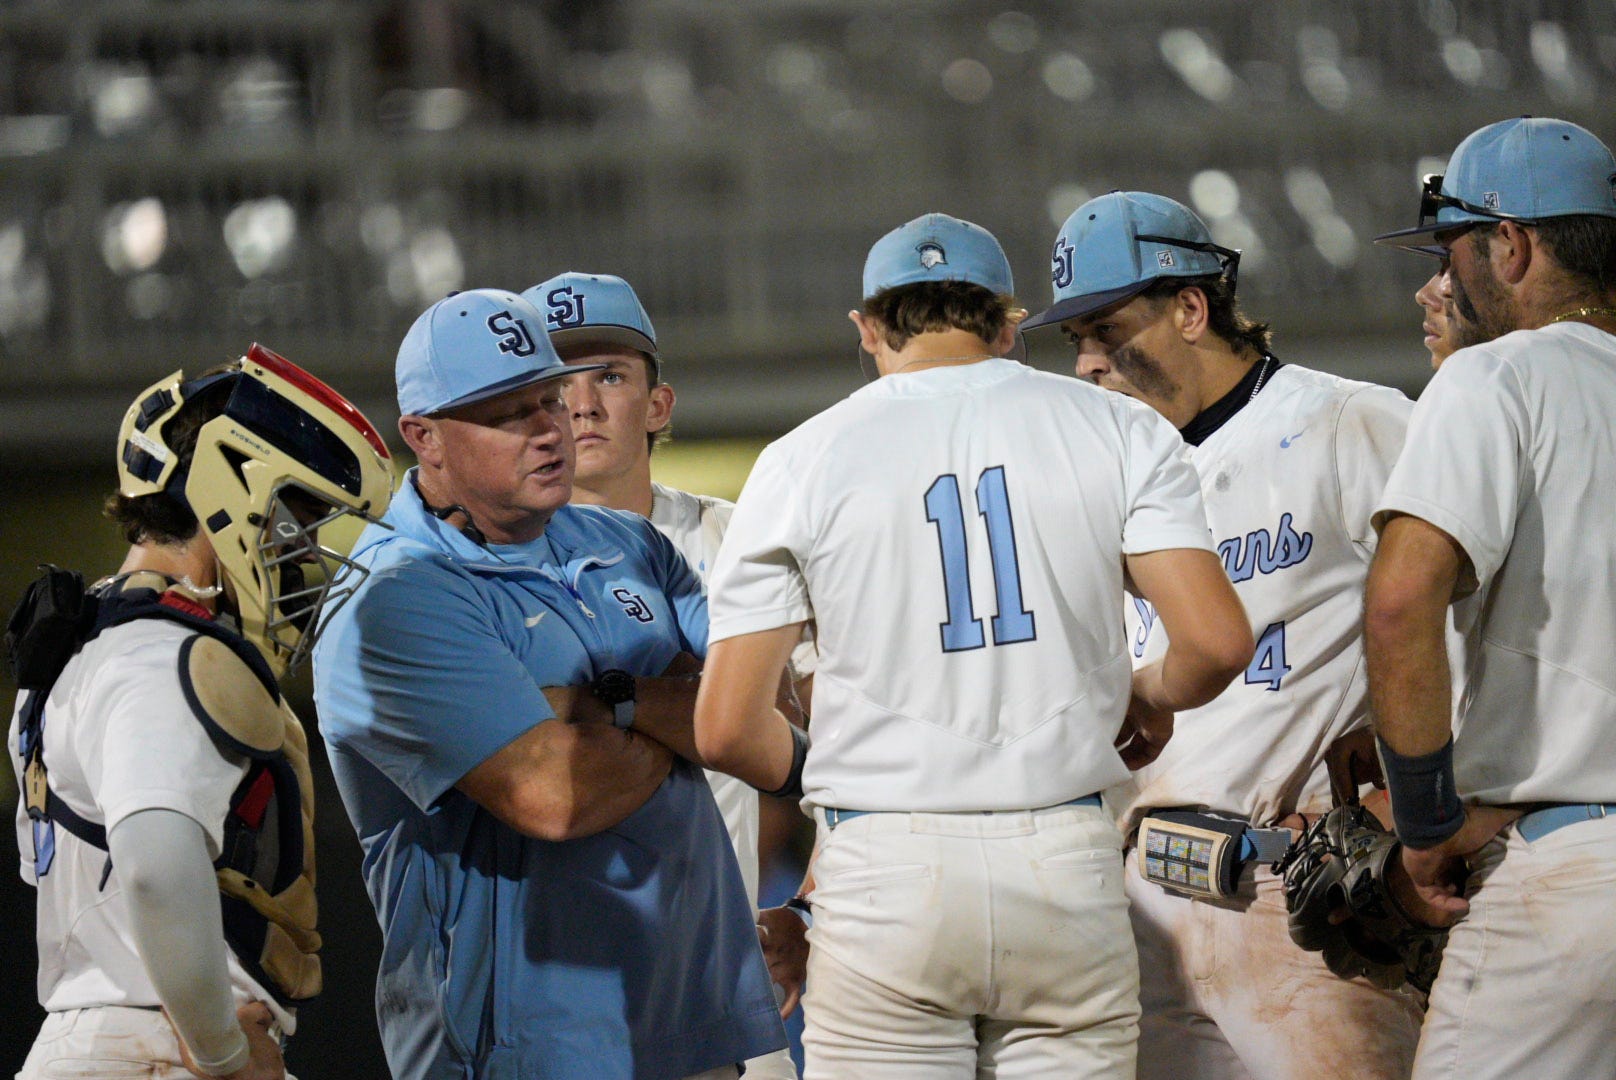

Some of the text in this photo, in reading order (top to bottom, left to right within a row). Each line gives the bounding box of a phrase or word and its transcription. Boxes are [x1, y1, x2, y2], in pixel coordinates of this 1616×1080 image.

[1052, 236, 1075, 289] SJ
[546, 286, 585, 328] SJ
[487, 310, 536, 359] SJ
[923, 464, 1037, 653] 11
[612, 588, 655, 624] SJ
[1245, 620, 1292, 691] 4
